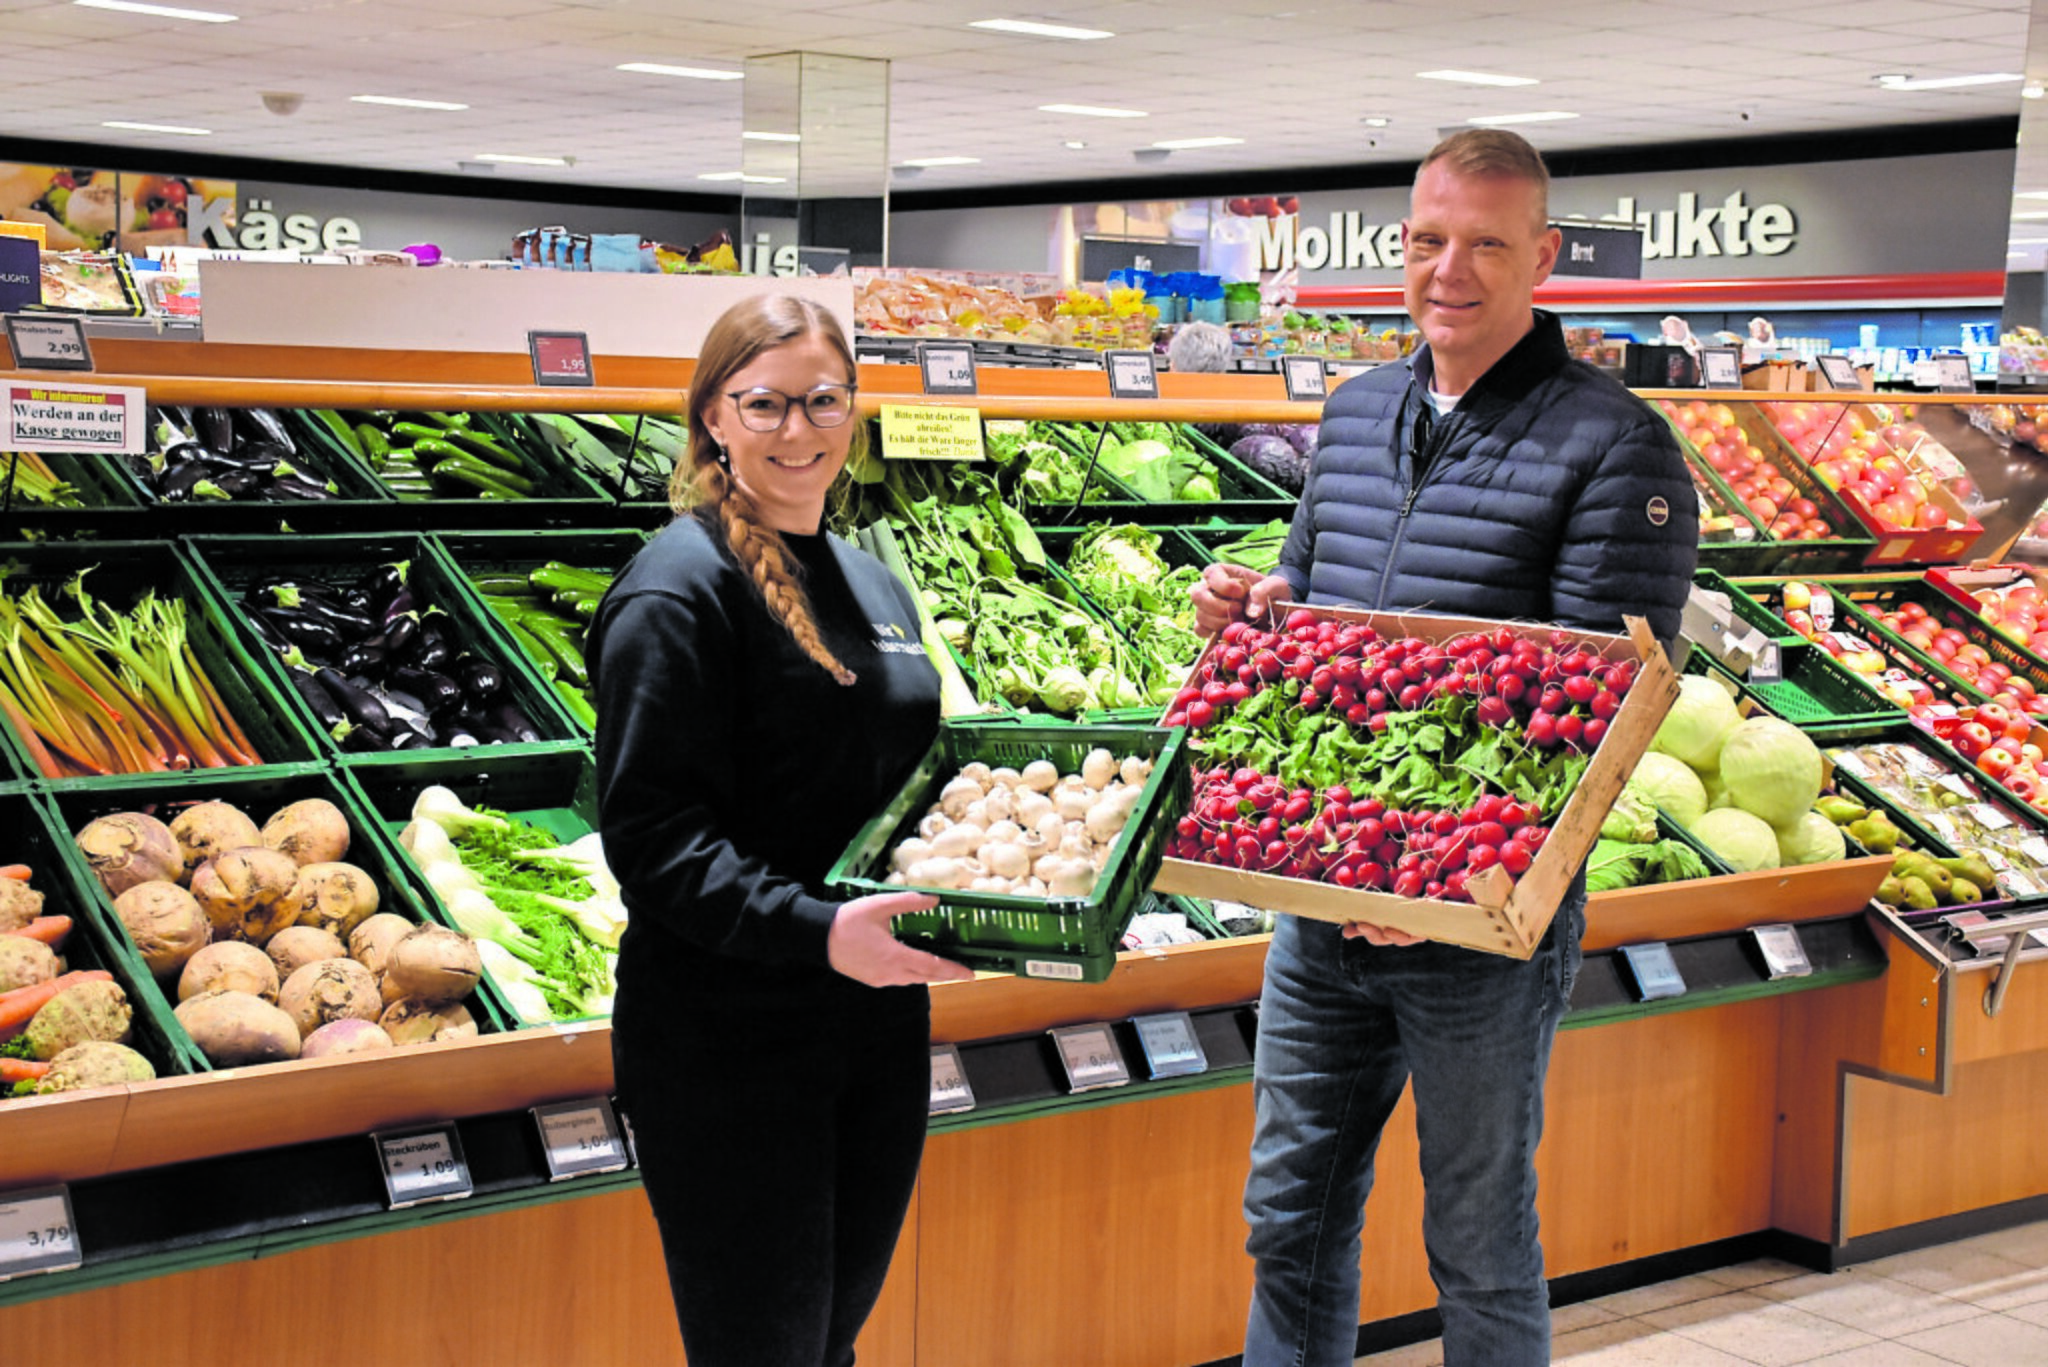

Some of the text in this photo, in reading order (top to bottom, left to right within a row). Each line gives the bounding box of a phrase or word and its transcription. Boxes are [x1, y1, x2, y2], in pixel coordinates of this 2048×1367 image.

[187, 194, 361, 254] Käse
[1568, 190, 1796, 258] ukte
[47, 341, 81, 355] 2,99
[561, 358, 585, 371] 1,99
[948, 369, 970, 380] 1,09
[30, 389, 47, 400] Wir
[14, 404, 124, 422] Werden an der
[894, 410, 912, 420] Bitte
[914, 411, 934, 421] nicht
[935, 412, 948, 421] das
[16, 422, 122, 440] Kasse gewogen
[577, 1135, 609, 1151] 1,09
[421, 1159, 455, 1177] 1,09
[27, 1226, 69, 1247] 3,79
